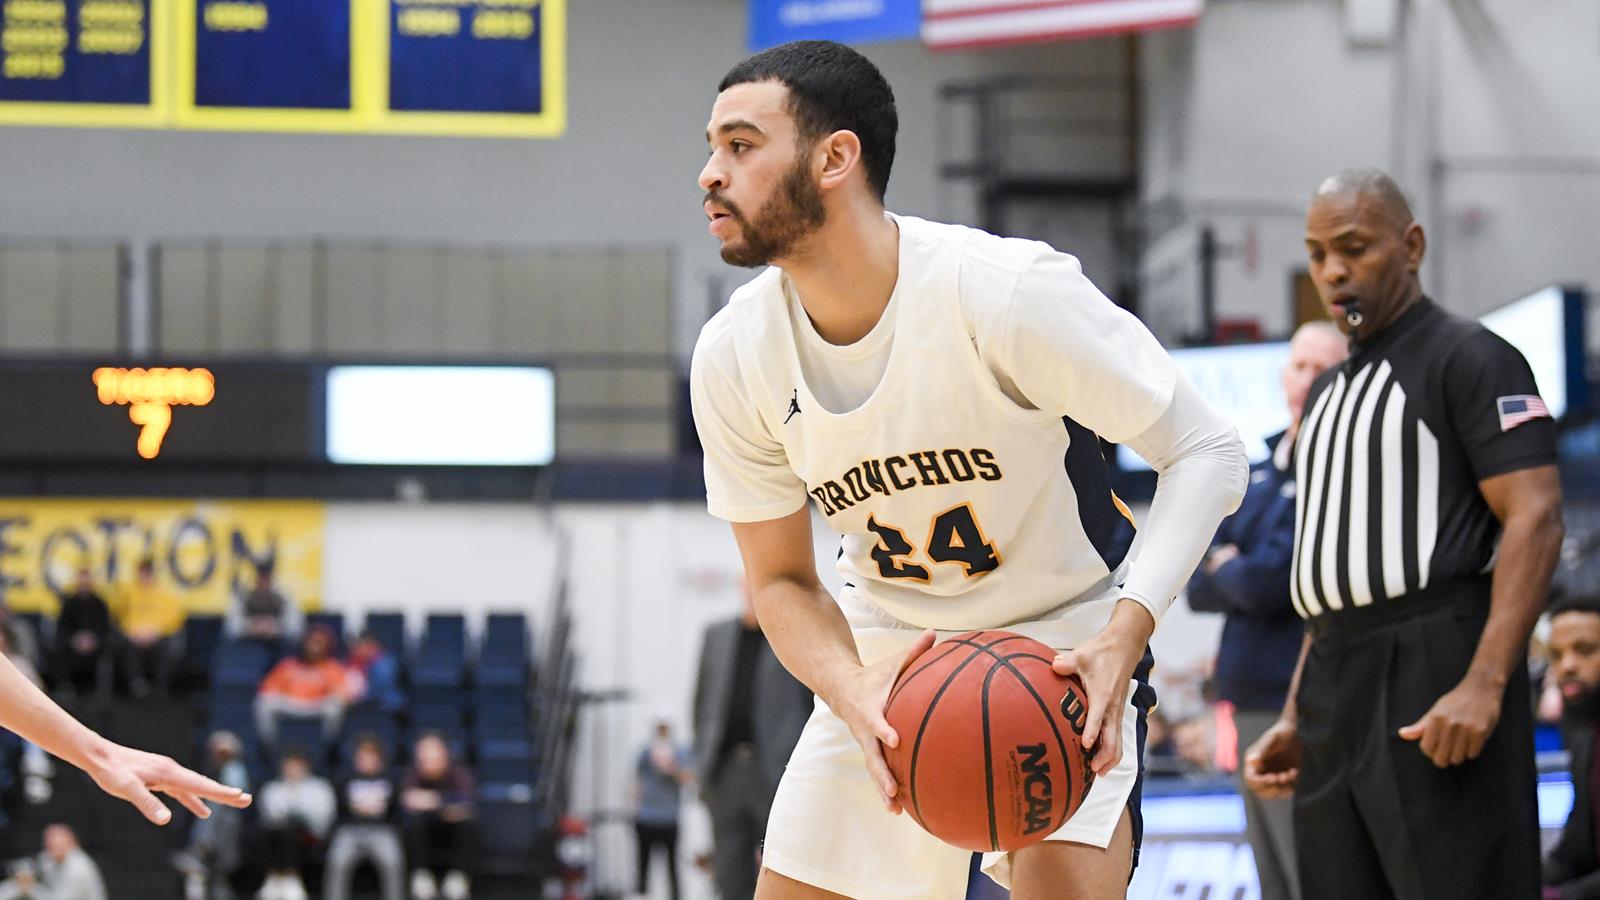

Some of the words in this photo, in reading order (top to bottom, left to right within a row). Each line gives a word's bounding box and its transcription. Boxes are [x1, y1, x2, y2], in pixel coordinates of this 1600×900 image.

[129, 402, 171, 458] 7
[811, 448, 1002, 517] BRONCHOS
[866, 502, 1004, 583] 24
[1016, 742, 1053, 835] NCAA
